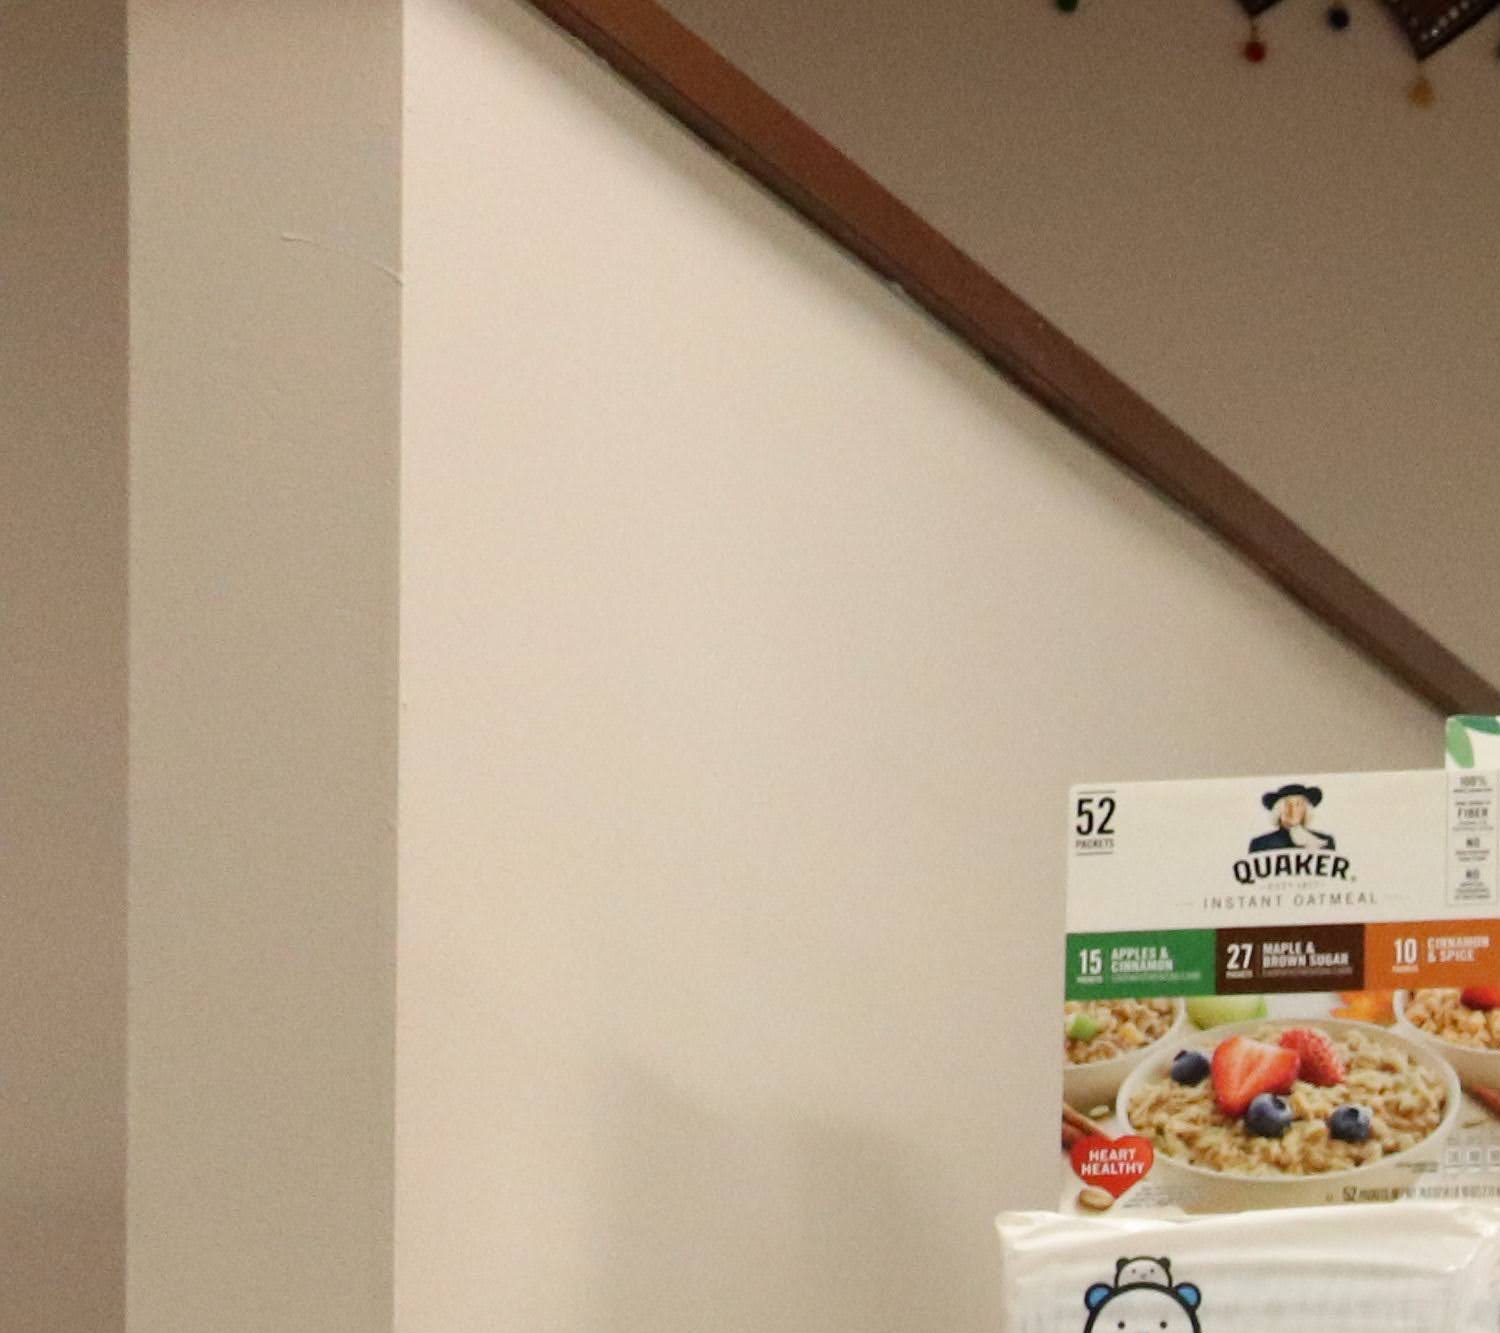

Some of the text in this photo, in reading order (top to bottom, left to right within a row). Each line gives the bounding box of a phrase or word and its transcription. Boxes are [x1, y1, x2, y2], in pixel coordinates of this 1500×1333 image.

[1075, 796, 1116, 836] 52
[1457, 807, 1489, 819] FIBER
[1075, 837, 1115, 849] PACKETS
[1233, 853, 1351, 885] QUAKER
[1203, 891, 1378, 911] INSTANT OATMEAL
[1226, 943, 1254, 970] 27
[1262, 952, 1350, 969] BROWN SUGAR
[1394, 937, 1418, 966] 10
[1079, 948, 1103, 976] 15
[1088, 1148, 1138, 1162] HEART
[1080, 1159, 1145, 1177] HEALTHY
